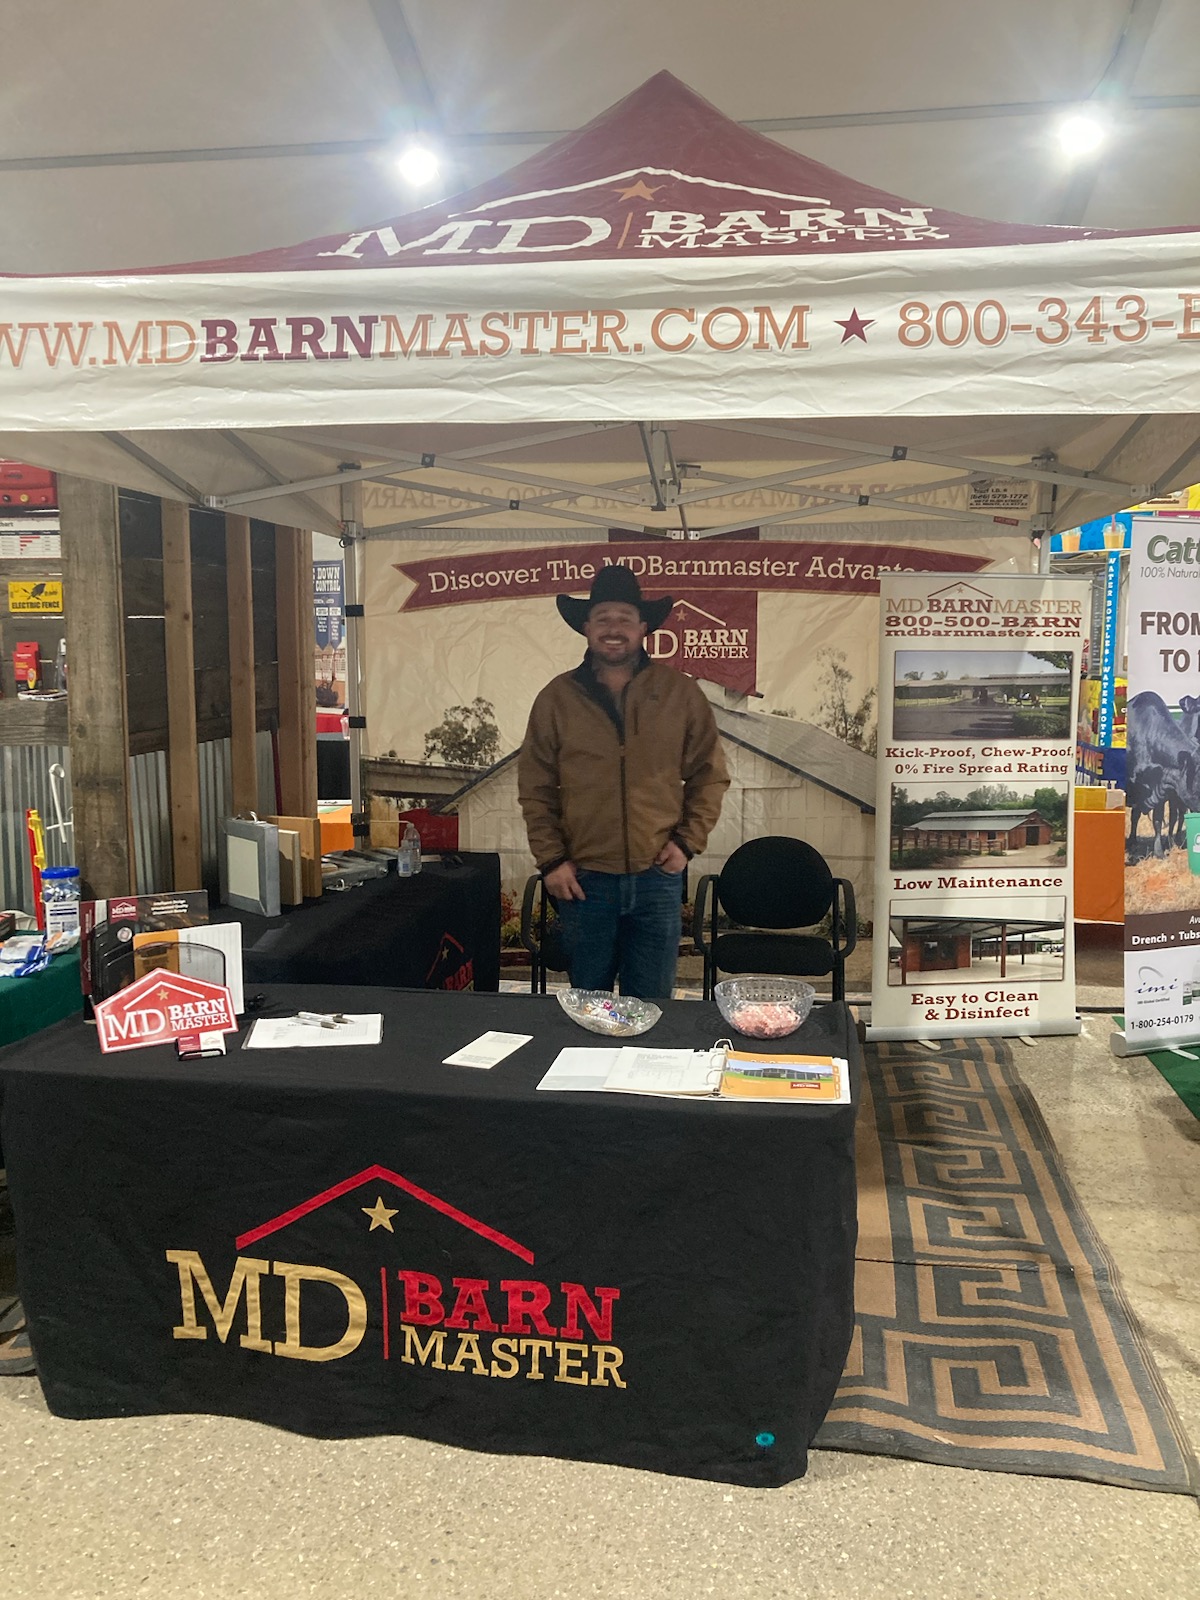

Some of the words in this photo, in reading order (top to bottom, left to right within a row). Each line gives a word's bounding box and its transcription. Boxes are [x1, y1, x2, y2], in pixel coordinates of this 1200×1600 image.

[643, 207, 936, 235] BARN
[317, 215, 612, 259] MD
[633, 226, 951, 250] MASTER
[317, 566, 340, 580] DOWN
[428, 565, 542, 593] Discover
[547, 559, 595, 582] The
[1107, 557, 1117, 597] WATER
[1140, 566, 1166, 578] 100%
[315, 580, 341, 592] CONTROL
[12, 601, 41, 609] ELECTRIC
[42, 601, 60, 609] FENCE
[885, 615, 1082, 629] 800-500-BARN
[1104, 600, 1113, 656] BOTTLES
[683, 629, 749, 646] BARN
[884, 627, 1081, 638] mdbarnmaster.com
[683, 646, 749, 659] MASTER
[1159, 648, 1191, 673] TO
[1101, 666, 1111, 704] WATER
[885, 747, 976, 760] Kick-Proof,
[980, 746, 1074, 759] Chew-Proof,
[894, 764, 919, 775] 0%
[922, 764, 955, 775] Fire
[958, 763, 1013, 776] Spread
[1017, 762, 1069, 776] Rating
[893, 877, 933, 890] Low
[937, 876, 1064, 889] Maintenance
[1131, 933, 1168, 946] Drench
[910, 992, 957, 1007] Easy
[961, 992, 979, 1004] to
[984, 990, 1039, 1004] Clean
[104, 1008, 166, 1042] MD
[168, 997, 226, 1021] BARN
[170, 1012, 230, 1032] MASTER
[924, 1008, 940, 1021] &
[945, 1006, 1031, 1020] Disinfect
[1131, 1013, 1195, 1030] 1-800-254-0179
[165, 1249, 368, 1363] MD
[397, 1269, 621, 1343] BARN
[399, 1324, 627, 1390] MASTER
